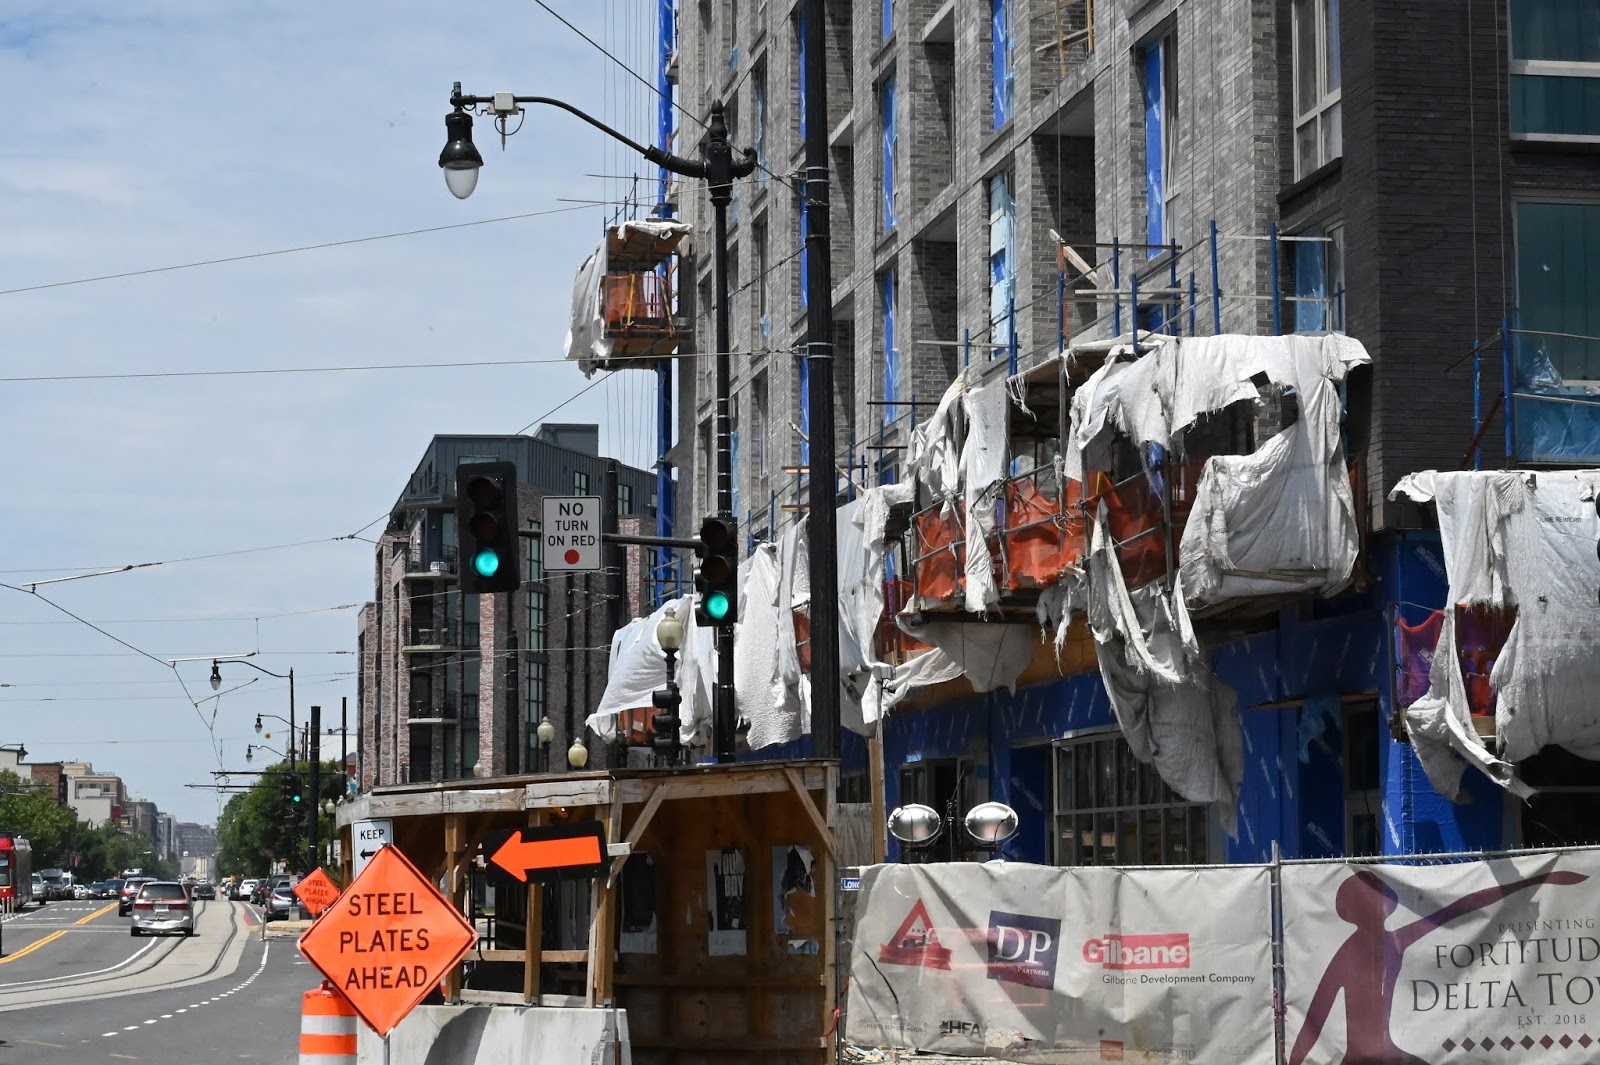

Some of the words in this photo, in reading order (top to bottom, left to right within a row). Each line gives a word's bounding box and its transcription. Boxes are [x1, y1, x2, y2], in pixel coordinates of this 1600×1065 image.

[559, 502, 584, 516] NO
[555, 520, 588, 531] TURN
[548, 535, 565, 546] ON
[571, 535, 596, 546] RED
[360, 828, 385, 840] KEEP
[308, 879, 327, 887] STEEL
[304, 888, 329, 897] PLATES
[305, 897, 328, 905] AHEAD
[348, 892, 423, 916] STEEL
[1499, 919, 1595, 933] PRESENTING
[339, 928, 429, 953] PLATES
[995, 925, 1052, 964] DP
[1082, 938, 1188, 965] Gilbane
[345, 965, 428, 990] AHEAD
[1102, 975, 1137, 985] Gilbane
[1140, 974, 1205, 984] Development
[1209, 973, 1256, 985] Company
[1410, 979, 1527, 1012] DELTA
[1518, 1015, 1547, 1027] EST.
[1555, 1014, 1586, 1025] 2018
